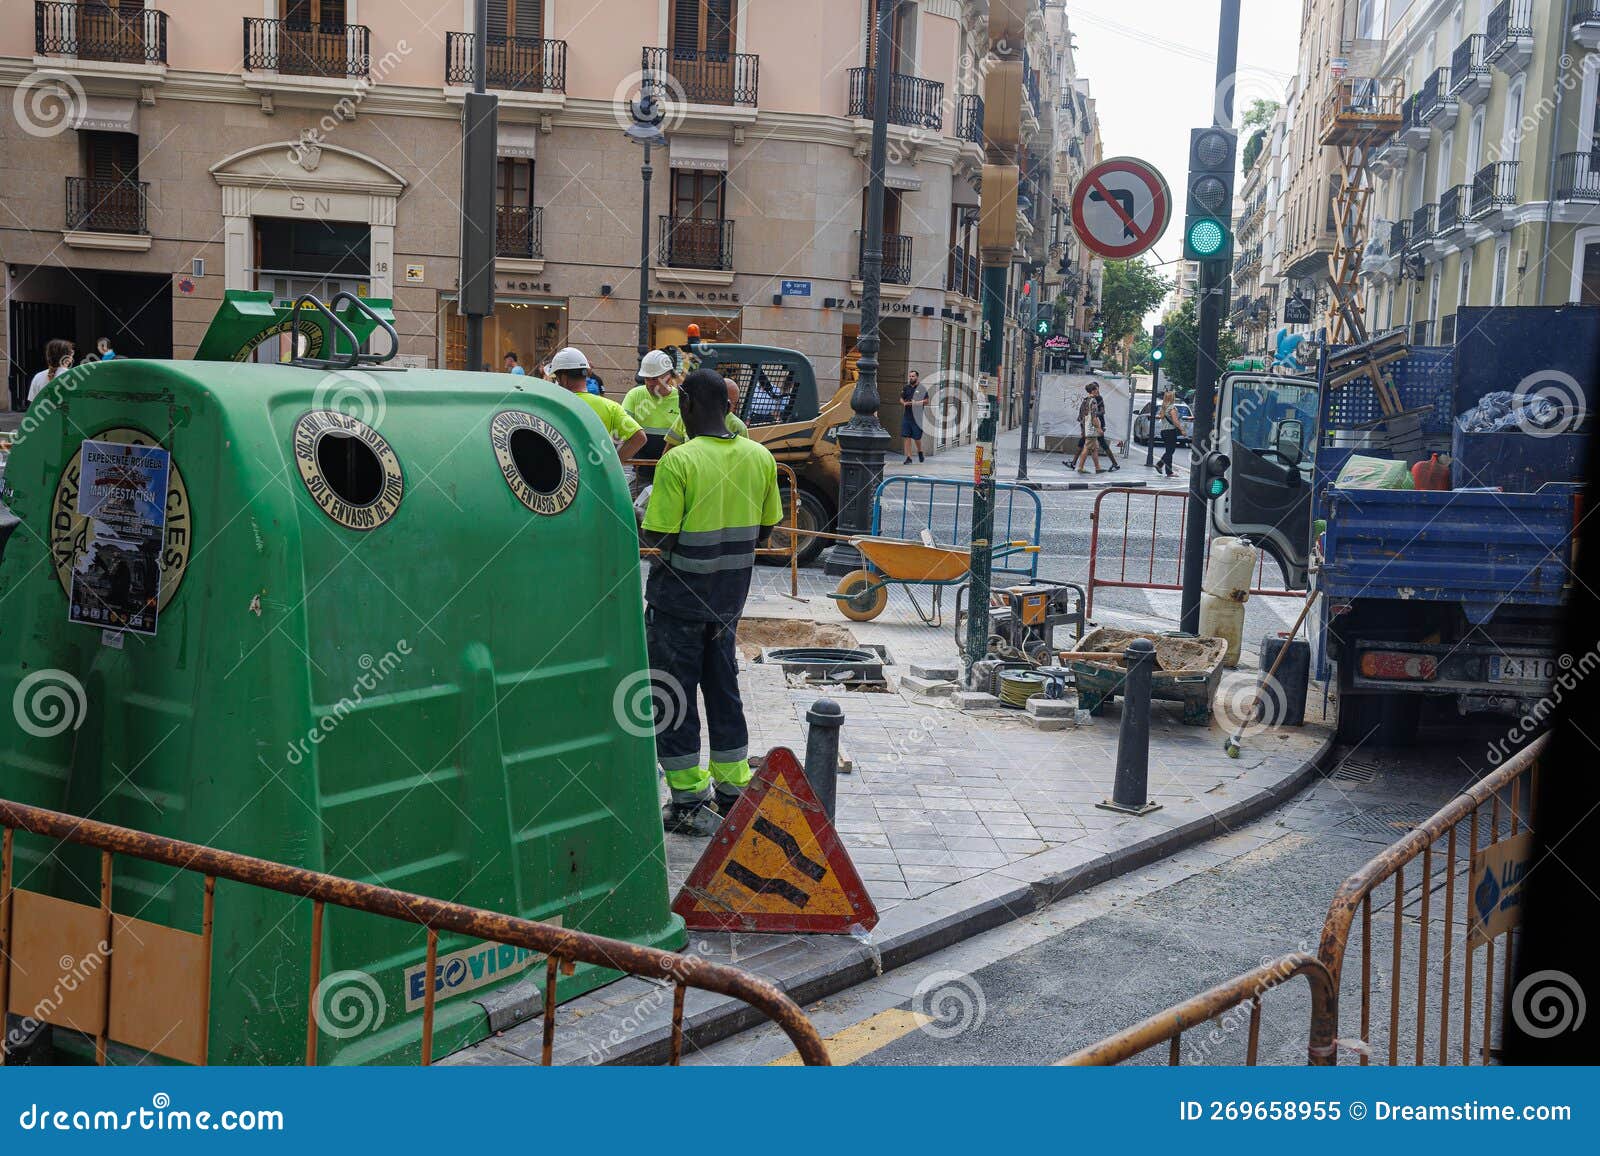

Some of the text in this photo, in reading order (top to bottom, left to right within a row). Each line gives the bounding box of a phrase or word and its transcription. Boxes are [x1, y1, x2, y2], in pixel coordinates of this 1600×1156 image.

[377, 262, 388, 273] 18
[507, 281, 552, 292] HOME
[697, 291, 740, 302] HOME
[837, 299, 921, 314] ZA HOME
[297, 412, 390, 462] SOLS ENVASOS DE VIDRE
[494, 426, 508, 452] SOLS
[529, 416, 542, 431] DE
[543, 423, 569, 453] VIDRE
[88, 452, 128, 467] EXPEDIENTE
[503, 464, 577, 513] SOLS ENVASOS DE VIDRE
[307, 472, 402, 527] SOLS ENVASOS DE VIDRE
[1504, 659, 1554, 678] 4110
[409, 944, 540, 1001] ECOVIDR
